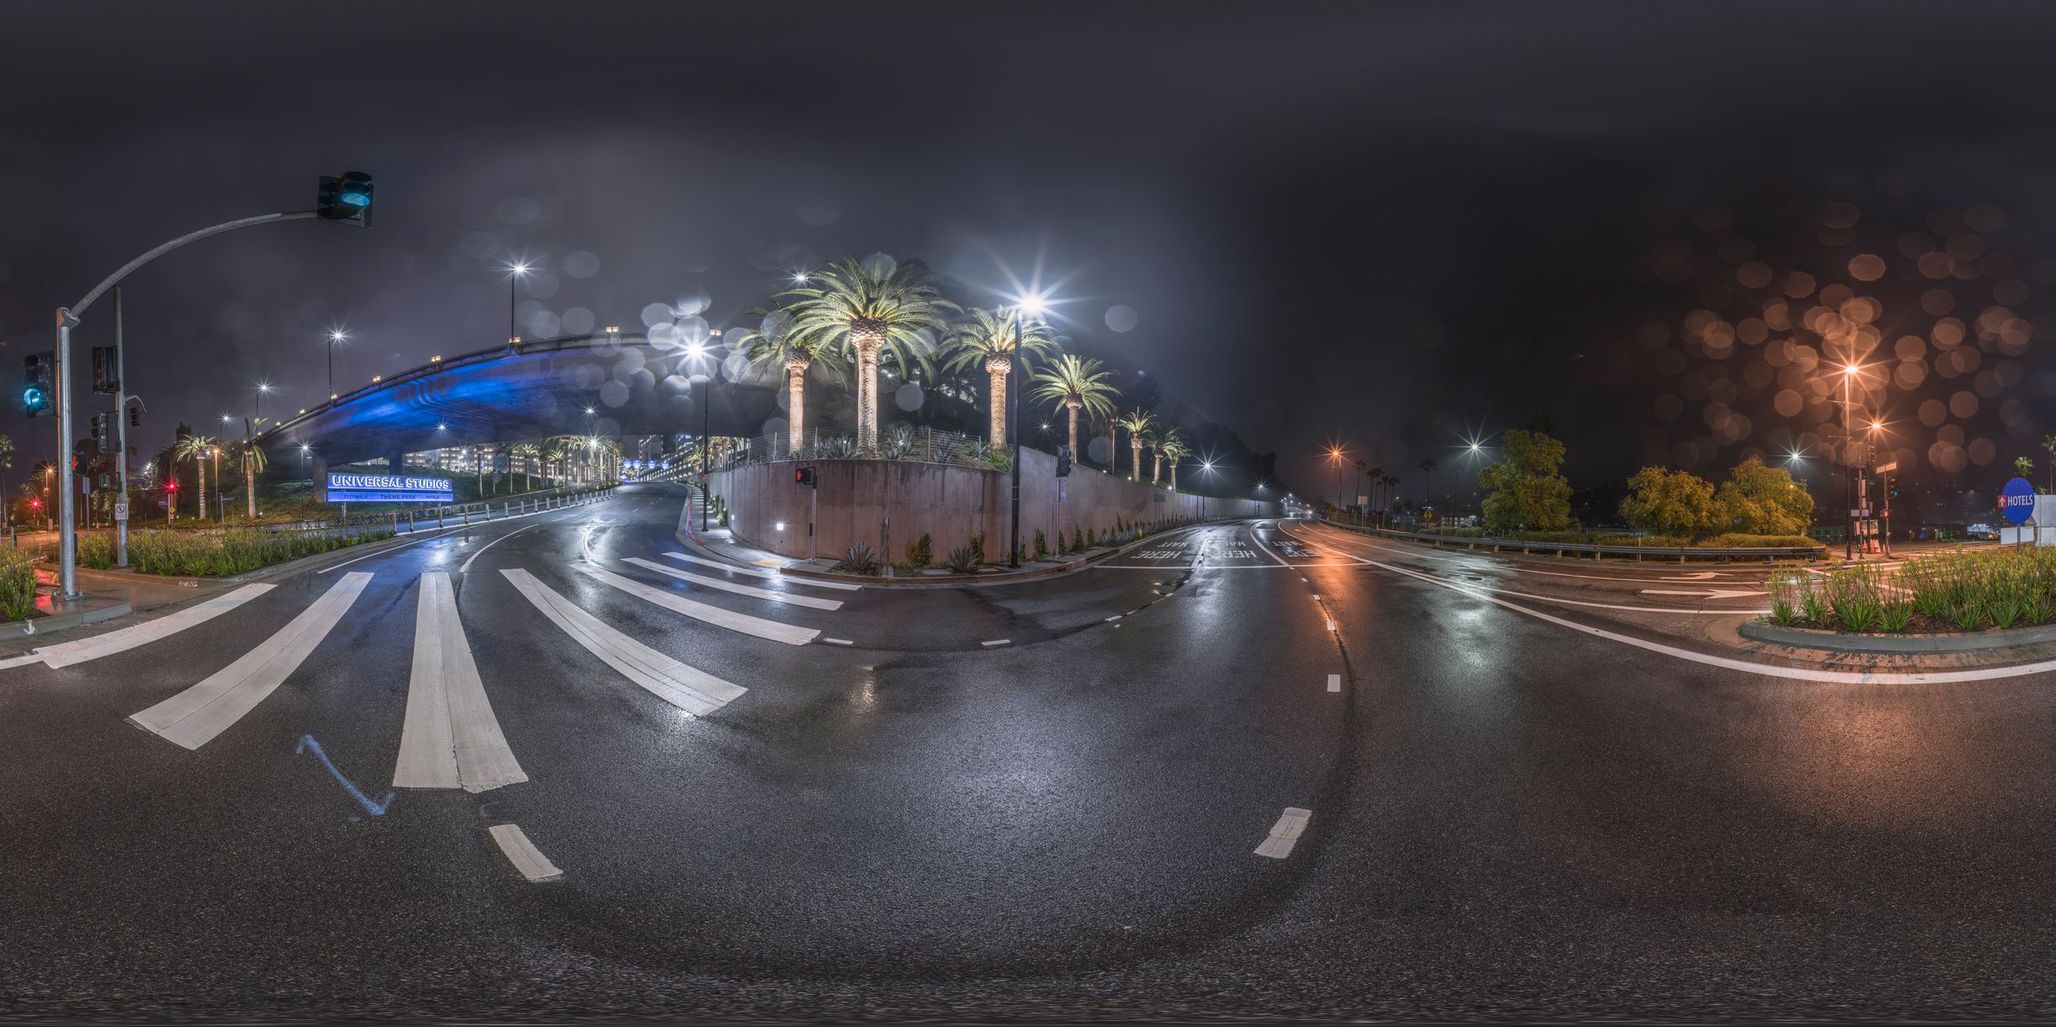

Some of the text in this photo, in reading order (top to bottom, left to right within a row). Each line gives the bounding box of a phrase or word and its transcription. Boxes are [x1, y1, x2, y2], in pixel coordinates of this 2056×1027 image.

[332, 475, 449, 489] UNIVERSAL STUDIOS
[2007, 495, 2033, 506] HOTELS
[1130, 550, 1182, 558] HERE
